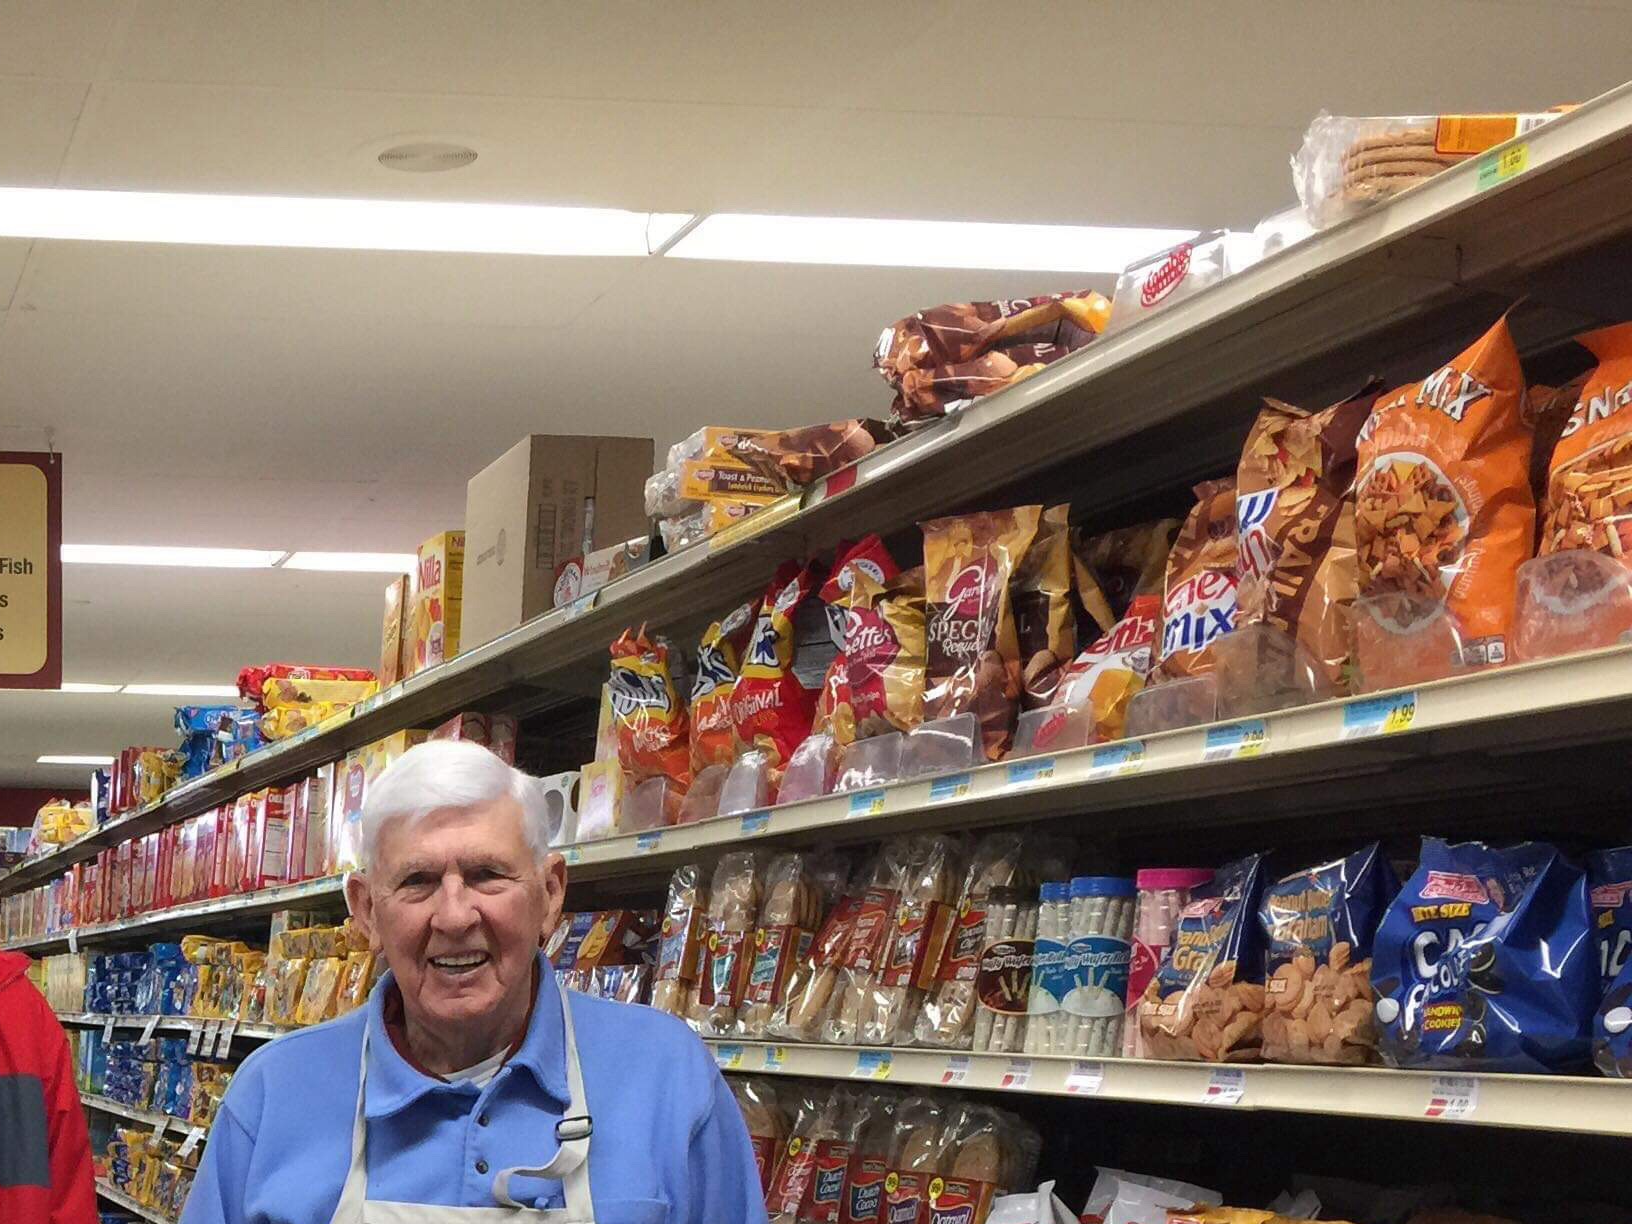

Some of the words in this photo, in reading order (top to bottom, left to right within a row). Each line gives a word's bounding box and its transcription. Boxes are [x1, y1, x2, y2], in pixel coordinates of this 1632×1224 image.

[719, 471, 737, 481] Toast
[418, 552, 441, 591] Nilla
[1390, 704, 1416, 725] 1.99
[1440, 903, 1472, 918] SIZE
